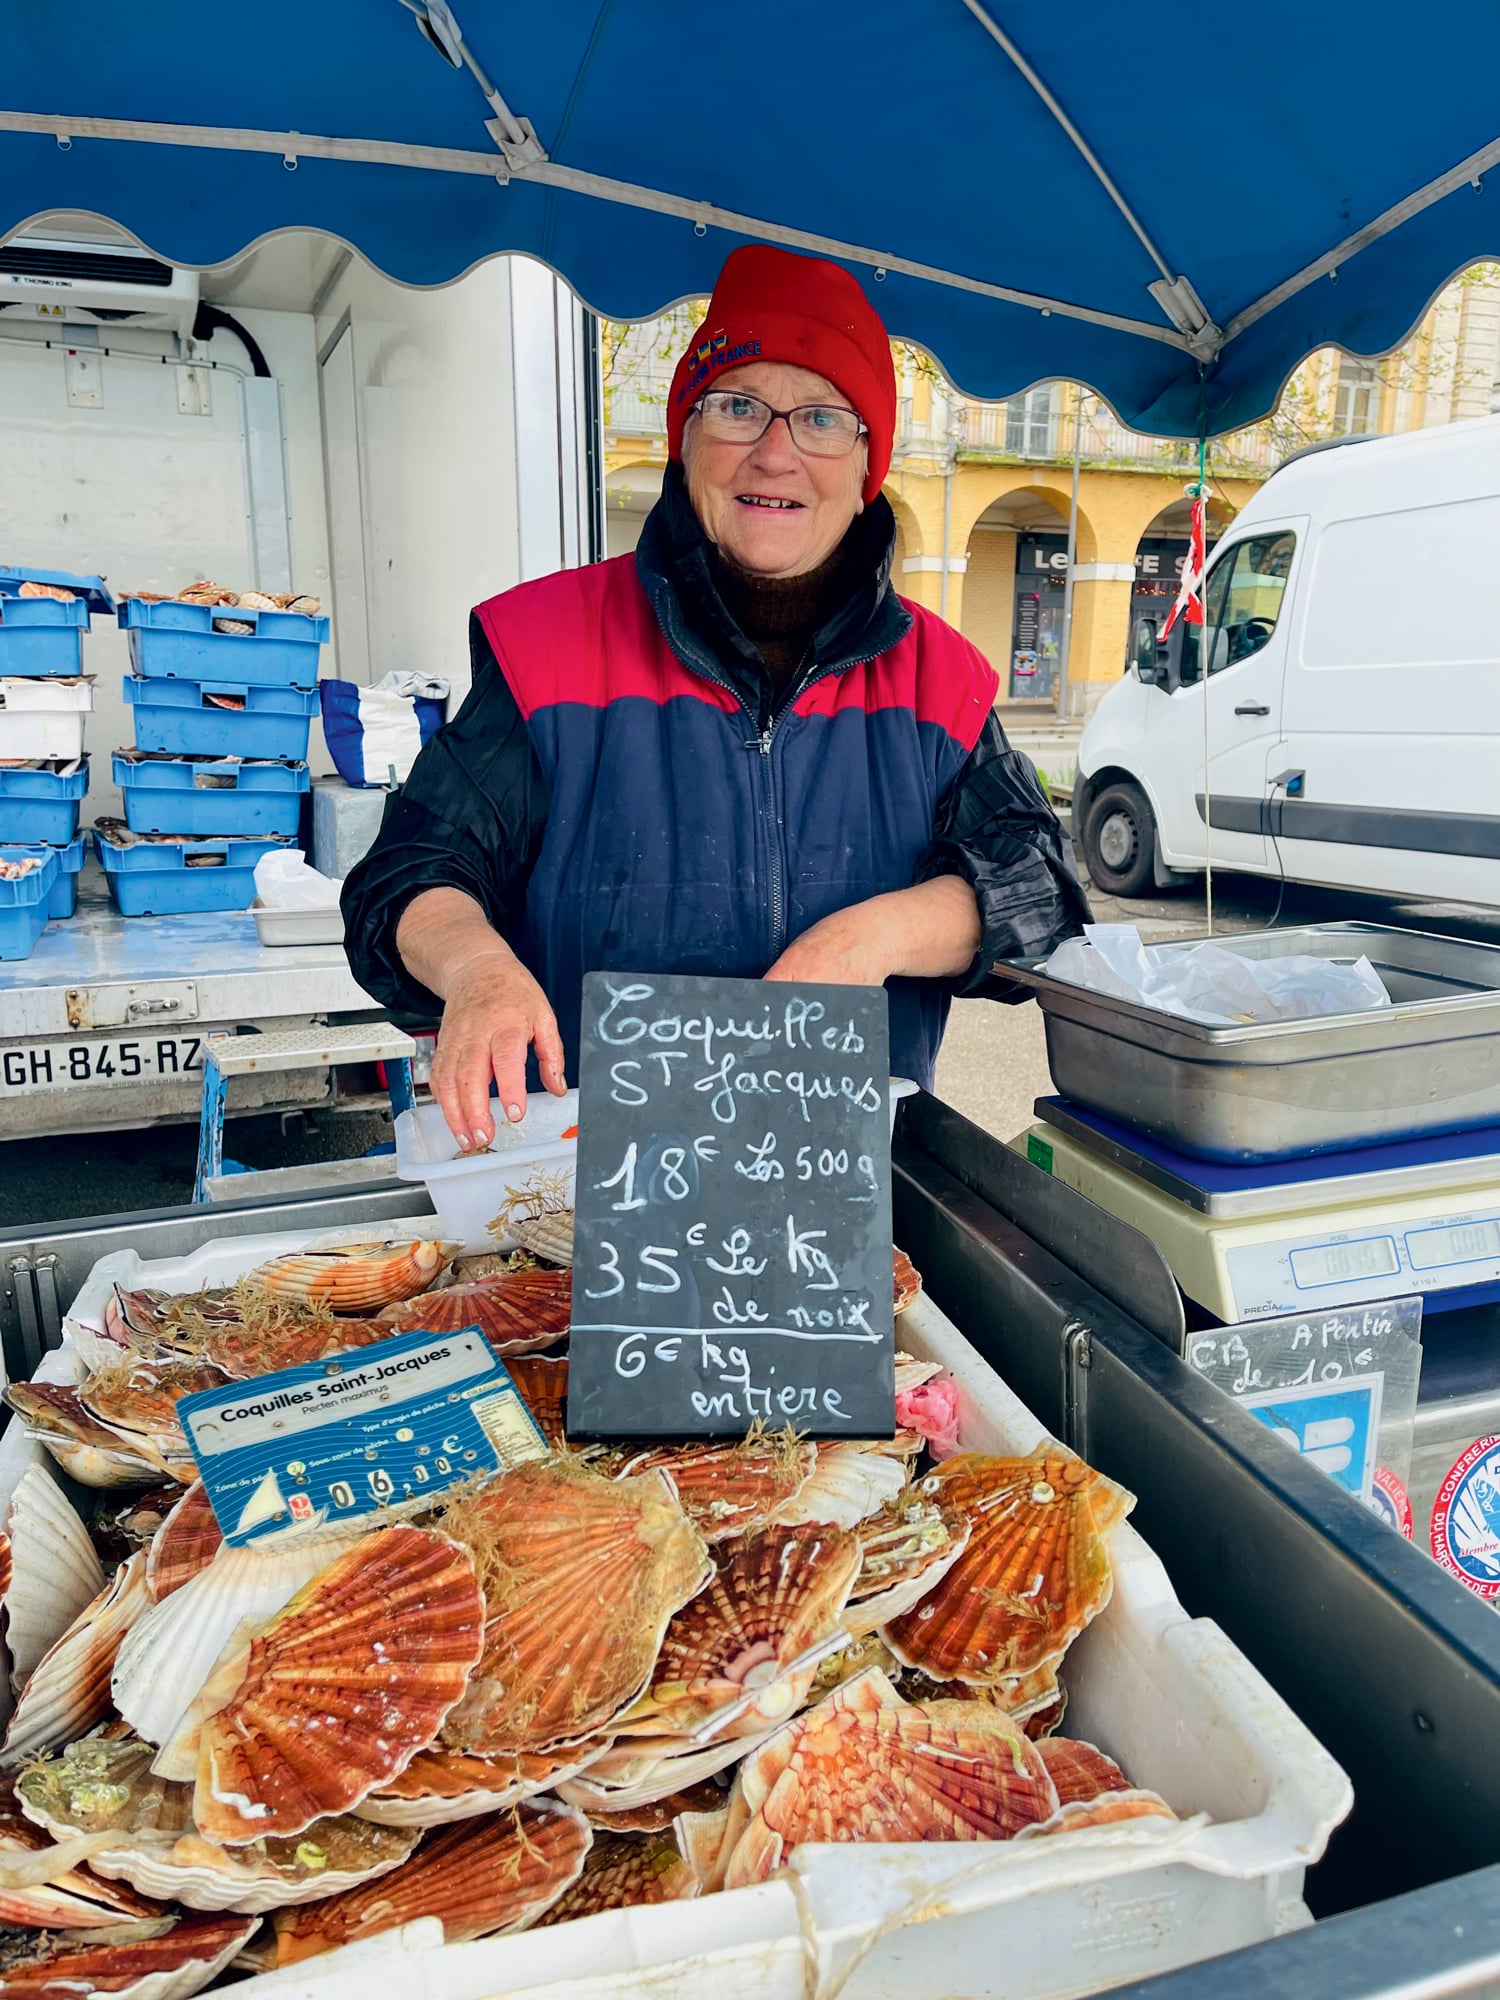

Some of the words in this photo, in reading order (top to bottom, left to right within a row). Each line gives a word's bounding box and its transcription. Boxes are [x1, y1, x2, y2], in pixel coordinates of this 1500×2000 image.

[24, 277, 54, 286] THERMO
[711, 340, 761, 368] FRANCE
[1035, 549, 1069, 570] Le
[3, 1038, 203, 1087] GH-845-RZ
[693, 1052, 881, 1123] Jacques
[713, 1286, 769, 1324] de
[786, 1297, 880, 1343] noix
[1244, 1304, 1278, 1315] PRECIA
[220, 1388, 314, 1423] Coquilles
[317, 1346, 452, 1398] Saint-Jacques
[1232, 1358, 1269, 1393] de
[301, 1398, 339, 1415] Pecten
[340, 1383, 390, 1405] maximus
[362, 1422, 380, 1433] Type
[215, 1481, 239, 1492] Zone
[239, 1478, 250, 1487] de
[309, 1451, 352, 1467] Sous-zone
[352, 1447, 364, 1455] de
[365, 1438, 390, 1452] pêche
[1434, 1512, 1446, 1531] DU
[1460, 1542, 1499, 1558] Membre
